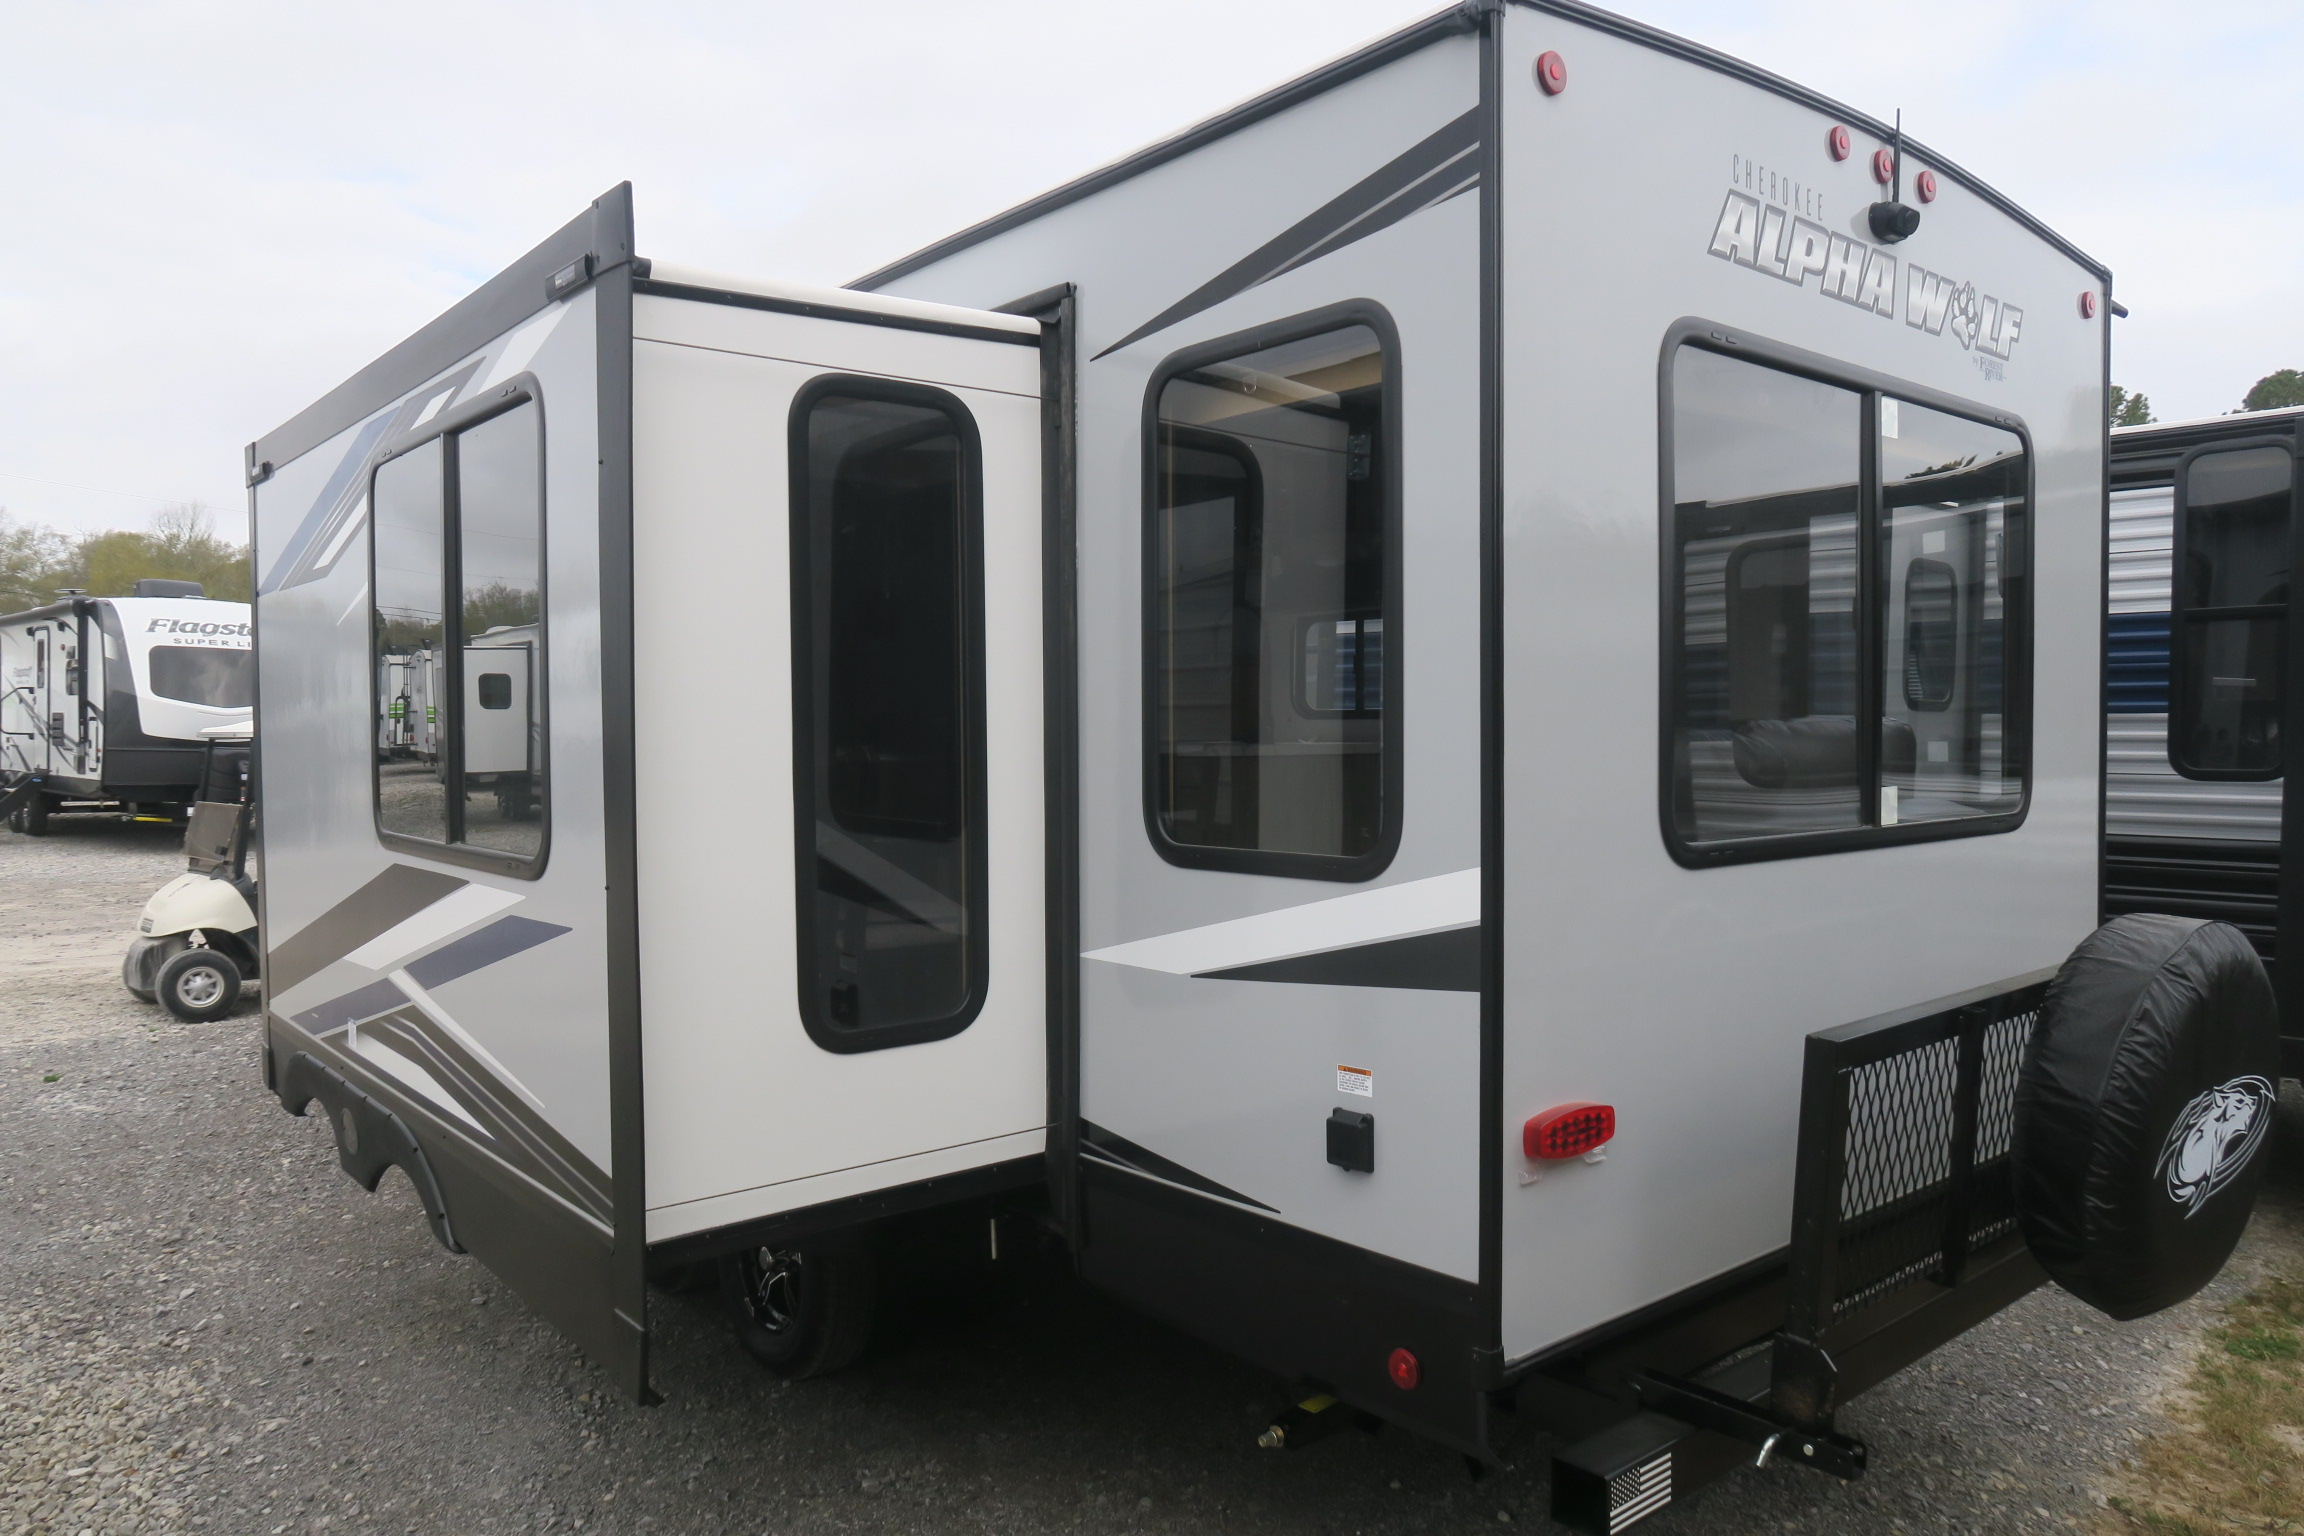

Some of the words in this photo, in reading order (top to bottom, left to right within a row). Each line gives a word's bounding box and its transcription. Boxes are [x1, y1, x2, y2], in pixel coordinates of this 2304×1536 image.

[1733, 154, 1823, 221] CHEROKEE
[1707, 188, 1897, 319] ALPHA
[1980, 356, 2004, 372] FOREST
[1984, 367, 2004, 381] RIVER
[173, 638, 230, 646] SUPER
